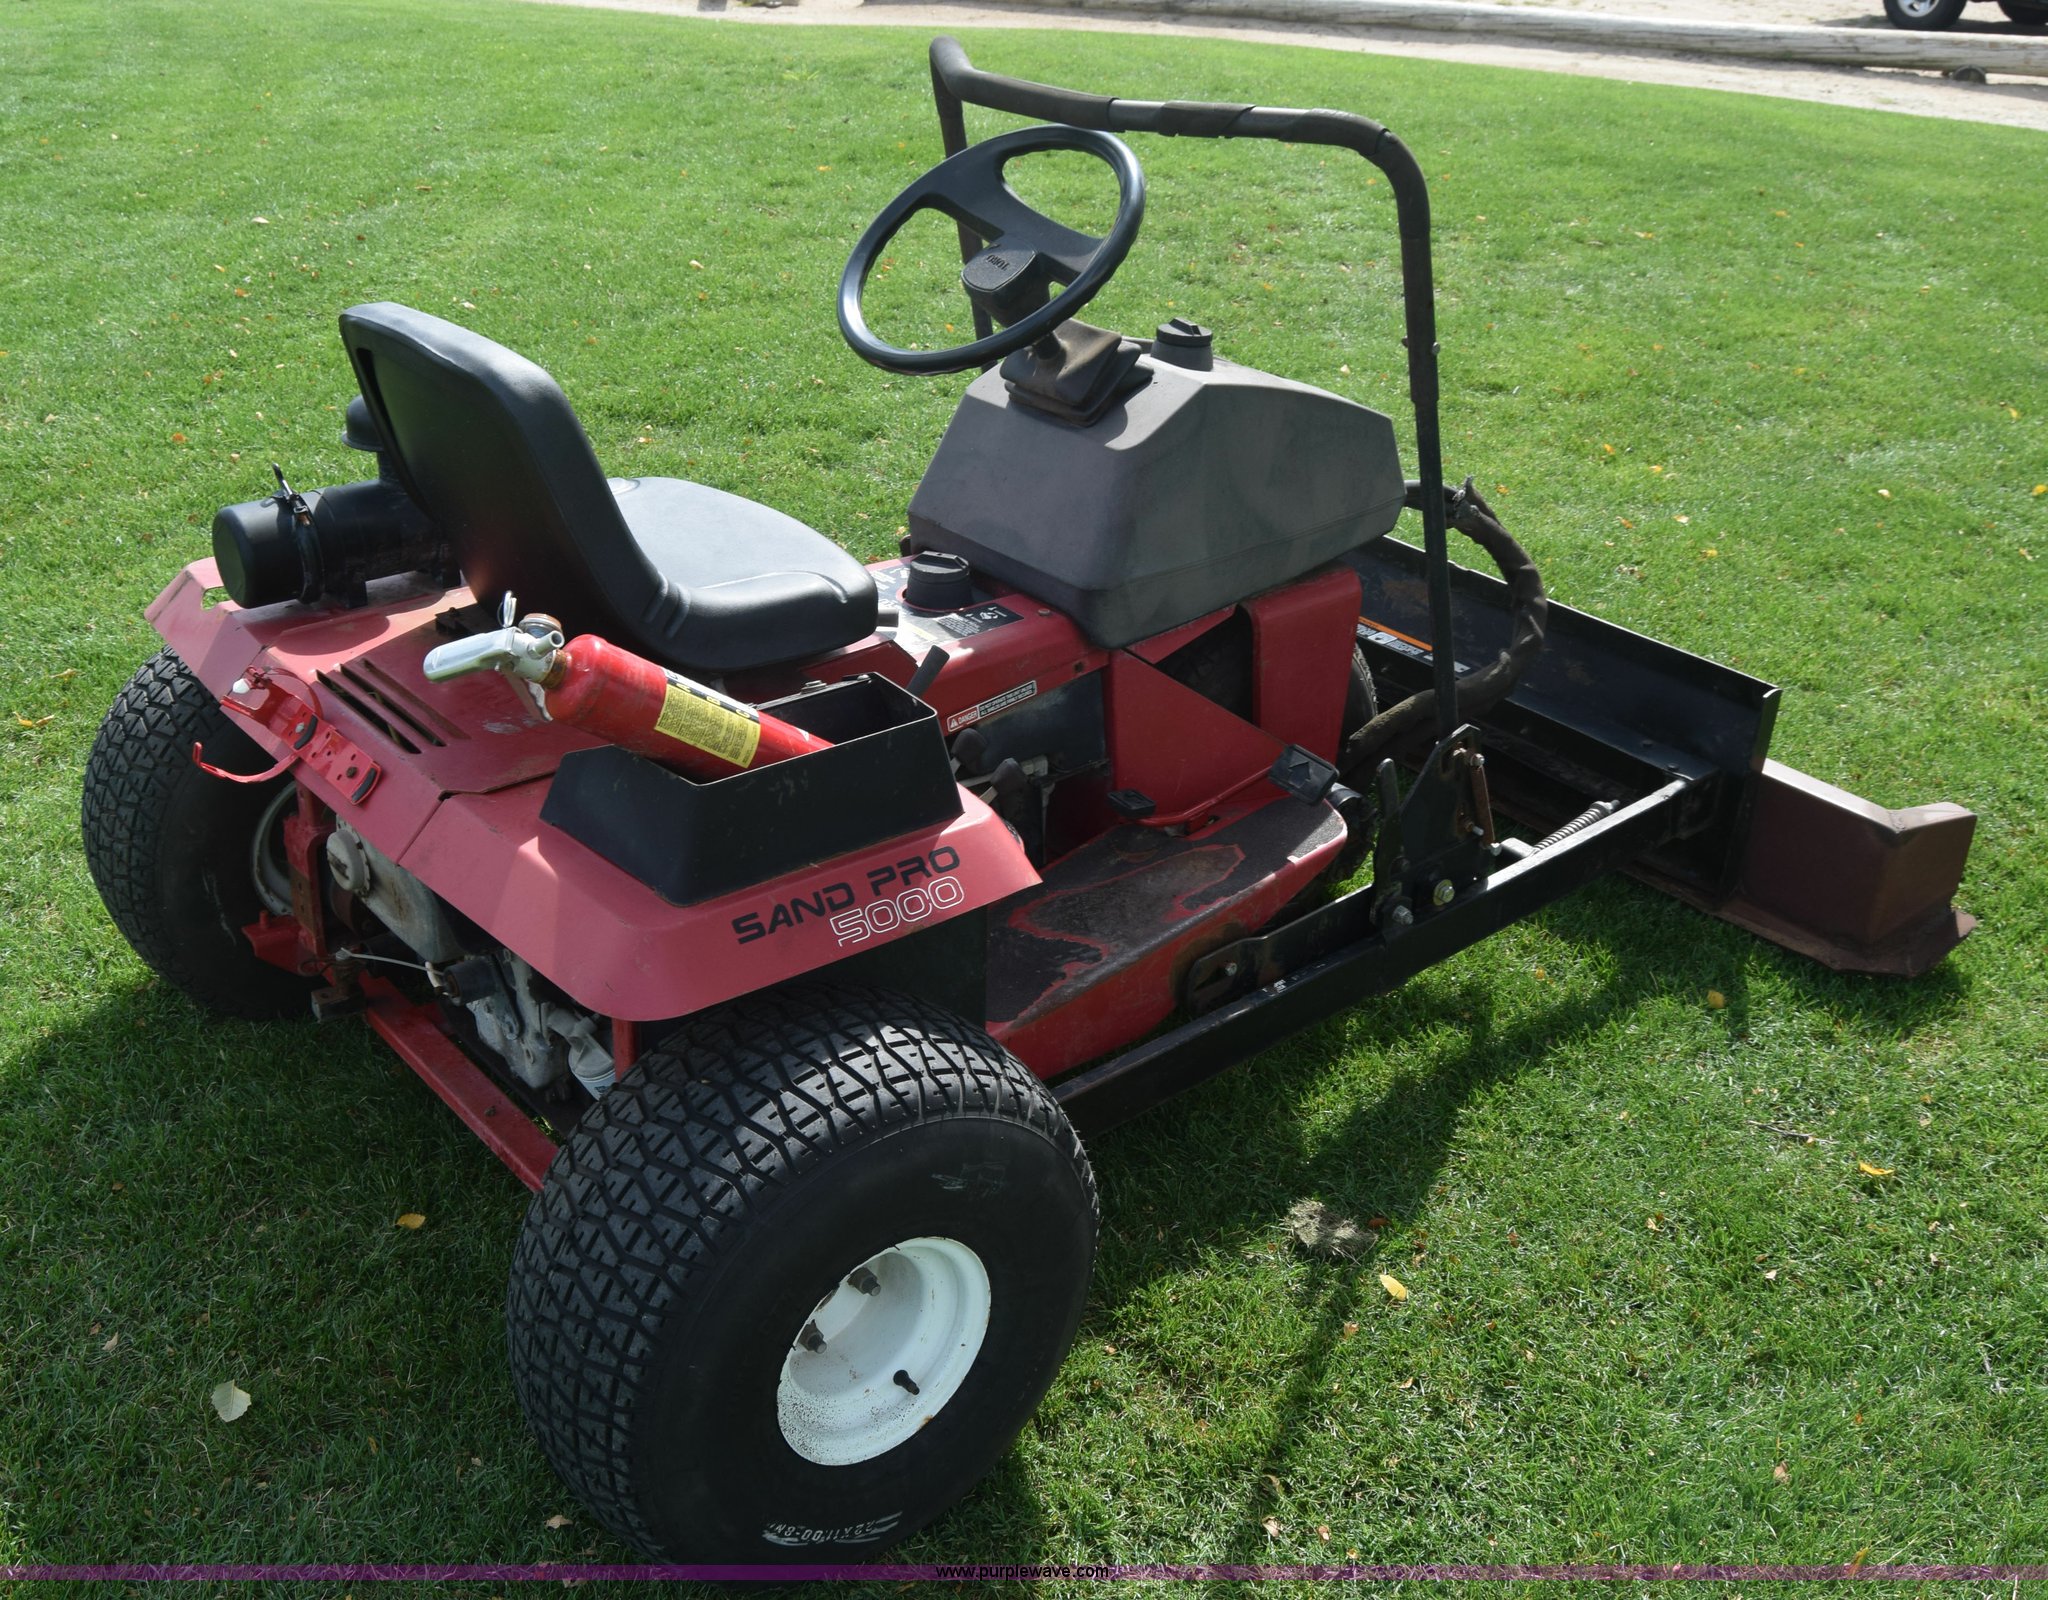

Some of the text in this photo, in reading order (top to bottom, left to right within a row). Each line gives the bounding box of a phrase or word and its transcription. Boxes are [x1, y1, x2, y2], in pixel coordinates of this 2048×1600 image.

[958, 711, 978, 723] DANGER
[731, 846, 960, 944] SAND PRO
[829, 876, 964, 947] 5000
